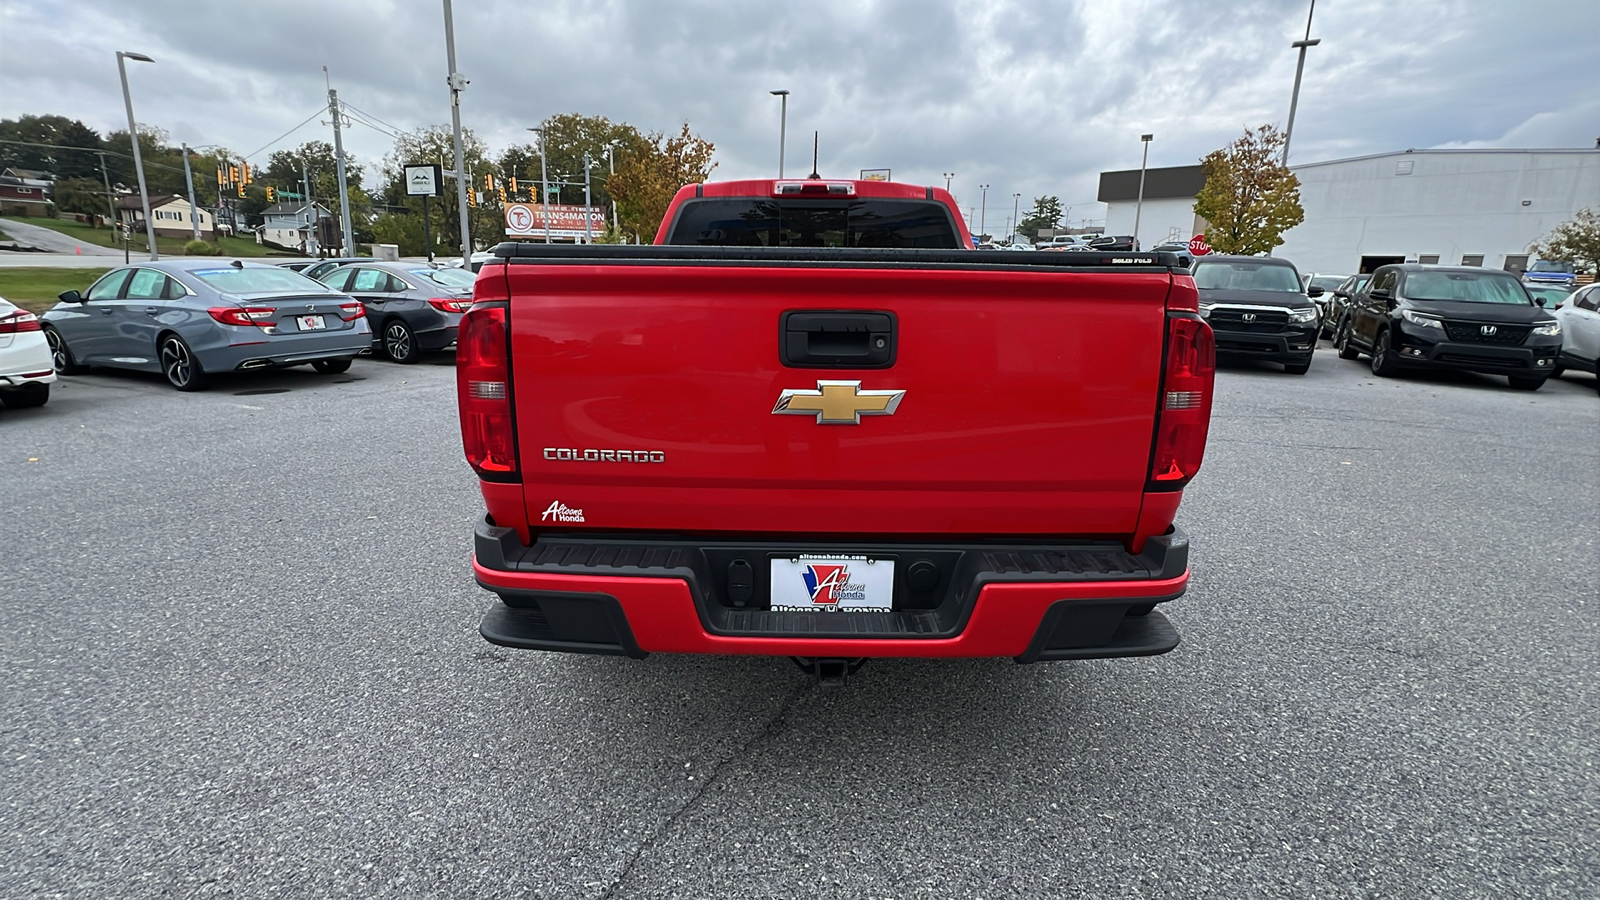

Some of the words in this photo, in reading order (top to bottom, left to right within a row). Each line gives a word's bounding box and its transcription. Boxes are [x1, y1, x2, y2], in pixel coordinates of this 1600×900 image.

[535, 211, 605, 221] TRANS4MATON
[543, 447, 665, 463] COLORADO
[541, 500, 583, 521] Altoona
[559, 513, 585, 522] Honda
[833, 589, 865, 600] Honda
